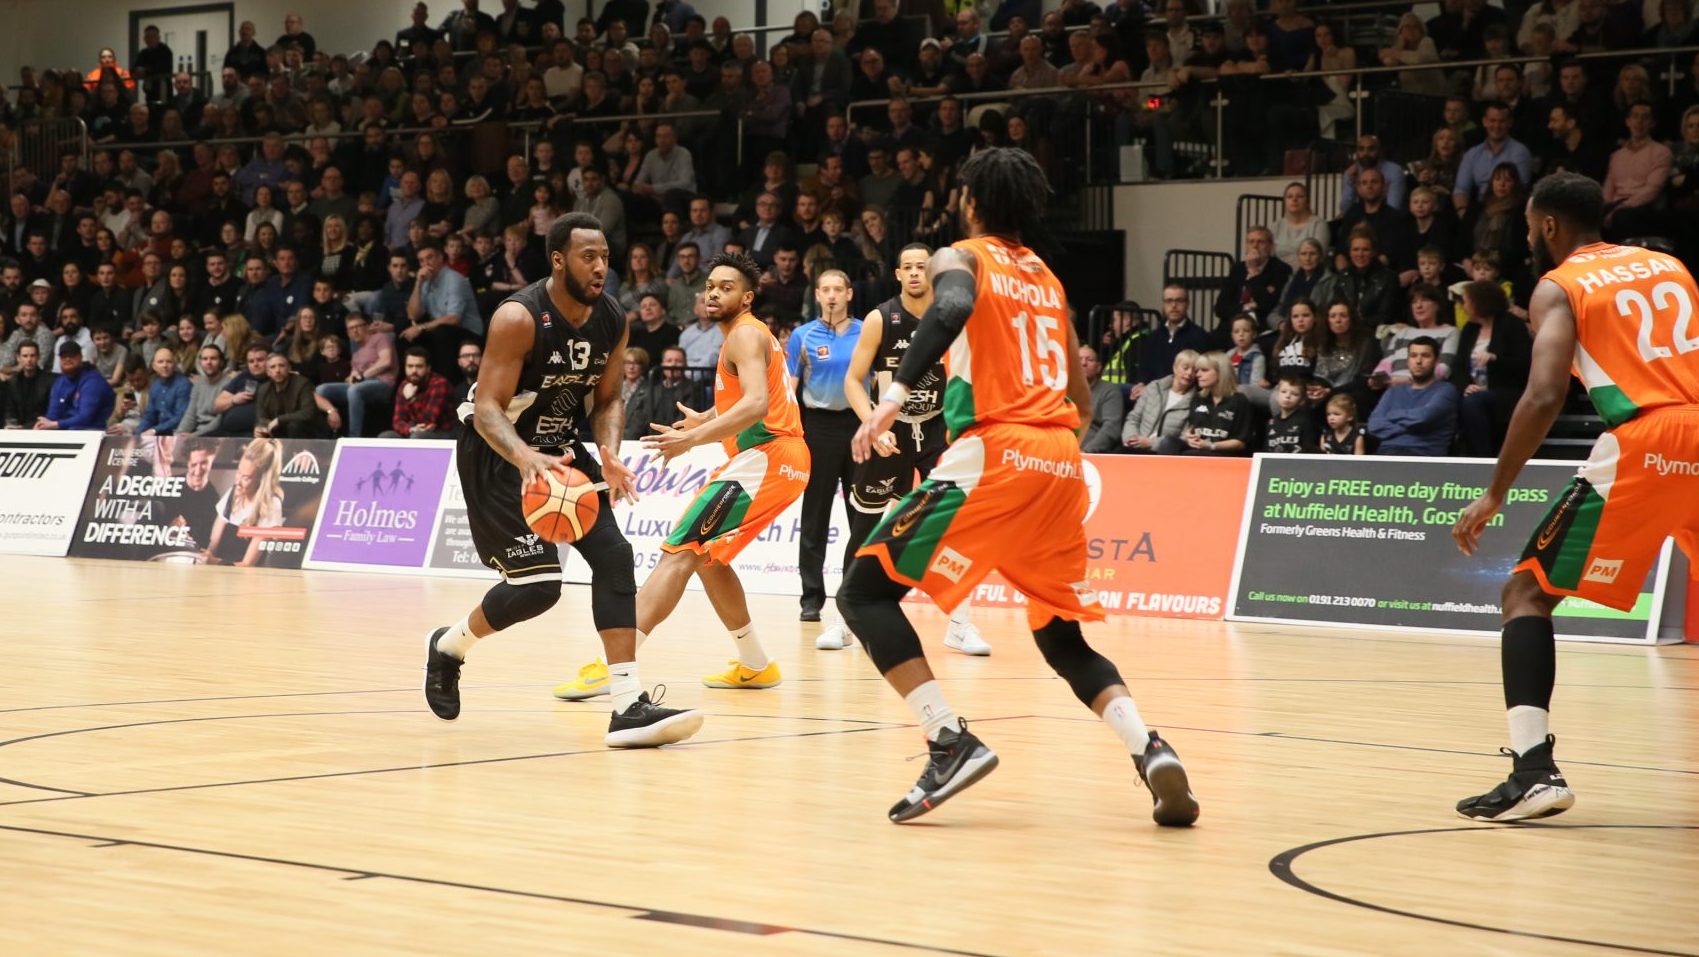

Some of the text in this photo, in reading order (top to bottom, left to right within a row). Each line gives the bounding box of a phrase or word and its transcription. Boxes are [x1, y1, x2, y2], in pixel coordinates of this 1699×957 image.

[1576, 258, 1683, 294] HASSAN
[1616, 281, 1699, 363] 22
[567, 339, 591, 370] 13
[1011, 311, 1067, 390] 15
[541, 375, 601, 388] EAGLE
[99, 475, 186, 497] A DEGREE
[1268, 478, 1548, 505] Enjoy a FREE one day fitne pass
[95, 499, 152, 520] WITH A
[333, 500, 419, 529] Holmes
[1264, 504, 1282, 518] at
[1283, 503, 1350, 521] Nuffield
[1352, 505, 1418, 525] Health,
[84, 522, 190, 546] DIFFERENCE
[343, 530, 398, 545] Family Law
[1260, 523, 1426, 541] Formerly Greens Health & Fitness
[938, 555, 964, 576] PM
[1590, 565, 1619, 578] PM
[1126, 591, 1221, 615] FLAVOURS
[1248, 591, 1264, 601] Call
[1276, 595, 1296, 603] now
[1309, 594, 1332, 605] 0191
[1333, 596, 1351, 606] 213
[1351, 597, 1376, 608] 0070
[1377, 600, 1388, 608] or
[1389, 599, 1408, 609] visit
[1409, 602, 1420, 610] us
[1421, 601, 1431, 610] at
